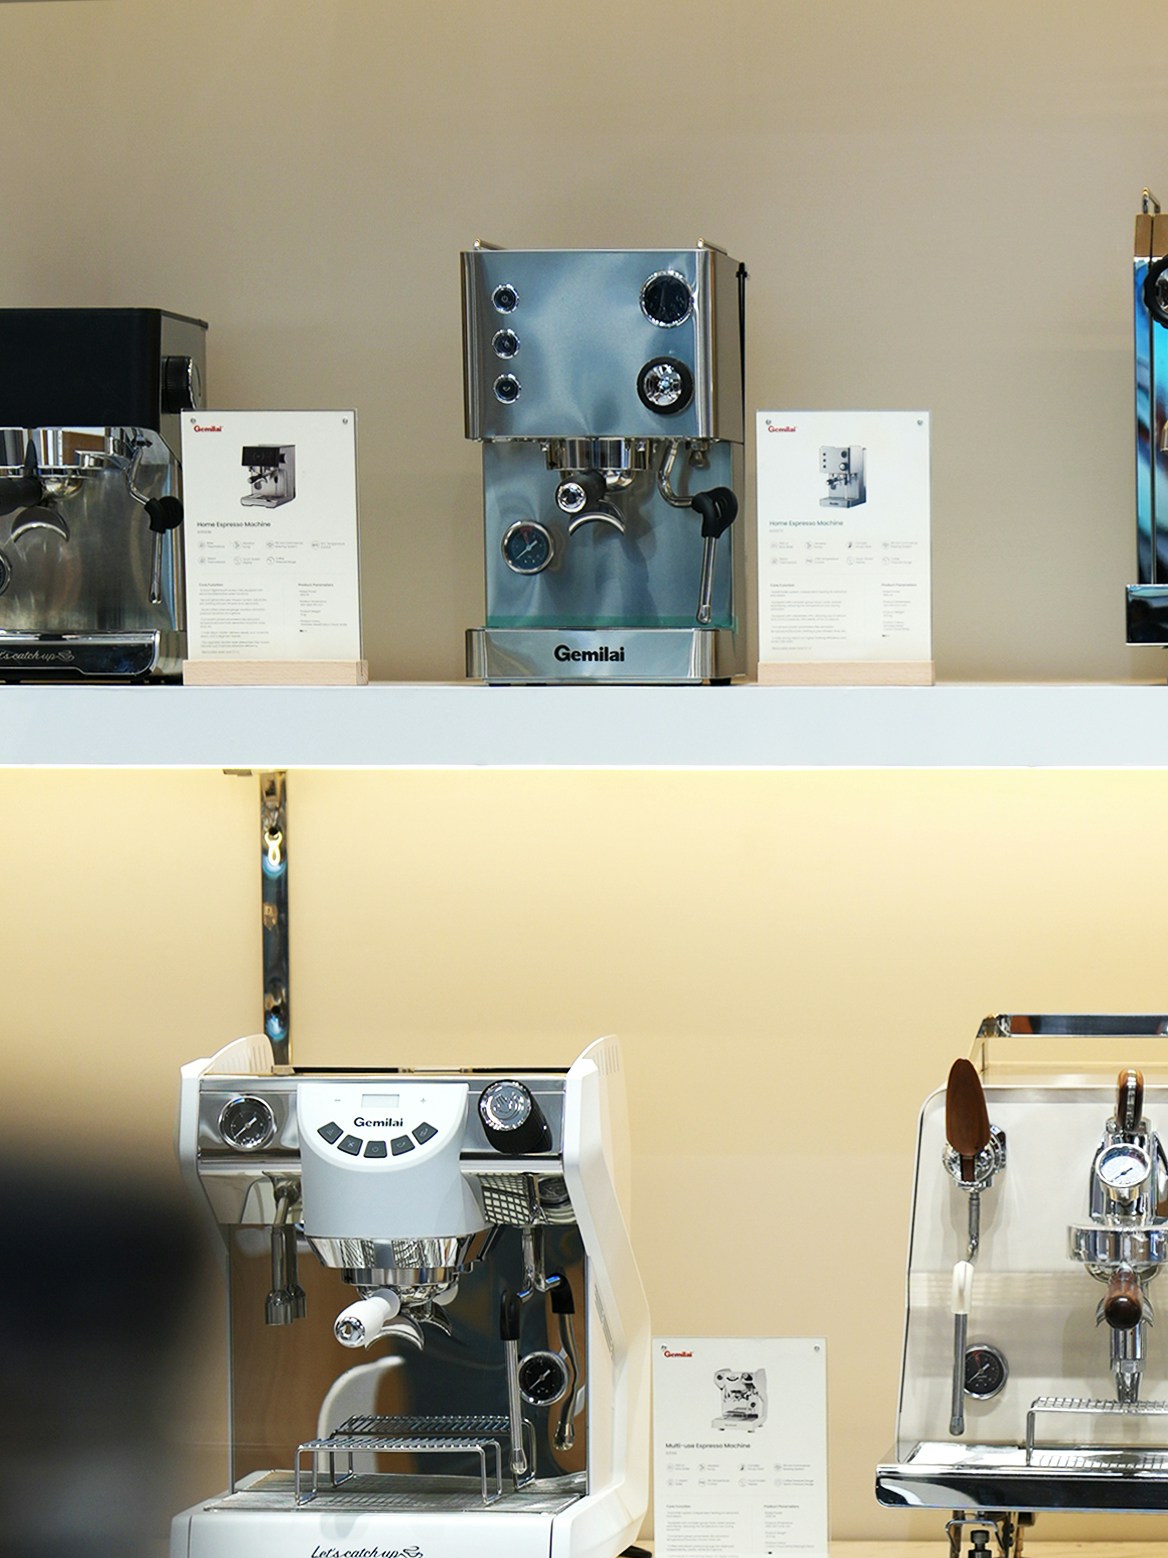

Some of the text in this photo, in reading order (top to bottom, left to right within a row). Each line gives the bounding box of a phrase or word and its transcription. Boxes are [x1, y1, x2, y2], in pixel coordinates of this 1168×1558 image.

[216, 521, 243, 529] Espresso
[12, 650, 40, 660] catch
[41, 652, 56, 662] up
[553, 643, 625, 662] Gemilai
[353, 1116, 404, 1128] Gemilai
[696, 1442, 723, 1450] Espresso
[311, 1545, 339, 1558] Let's
[341, 1546, 379, 1558] catch
